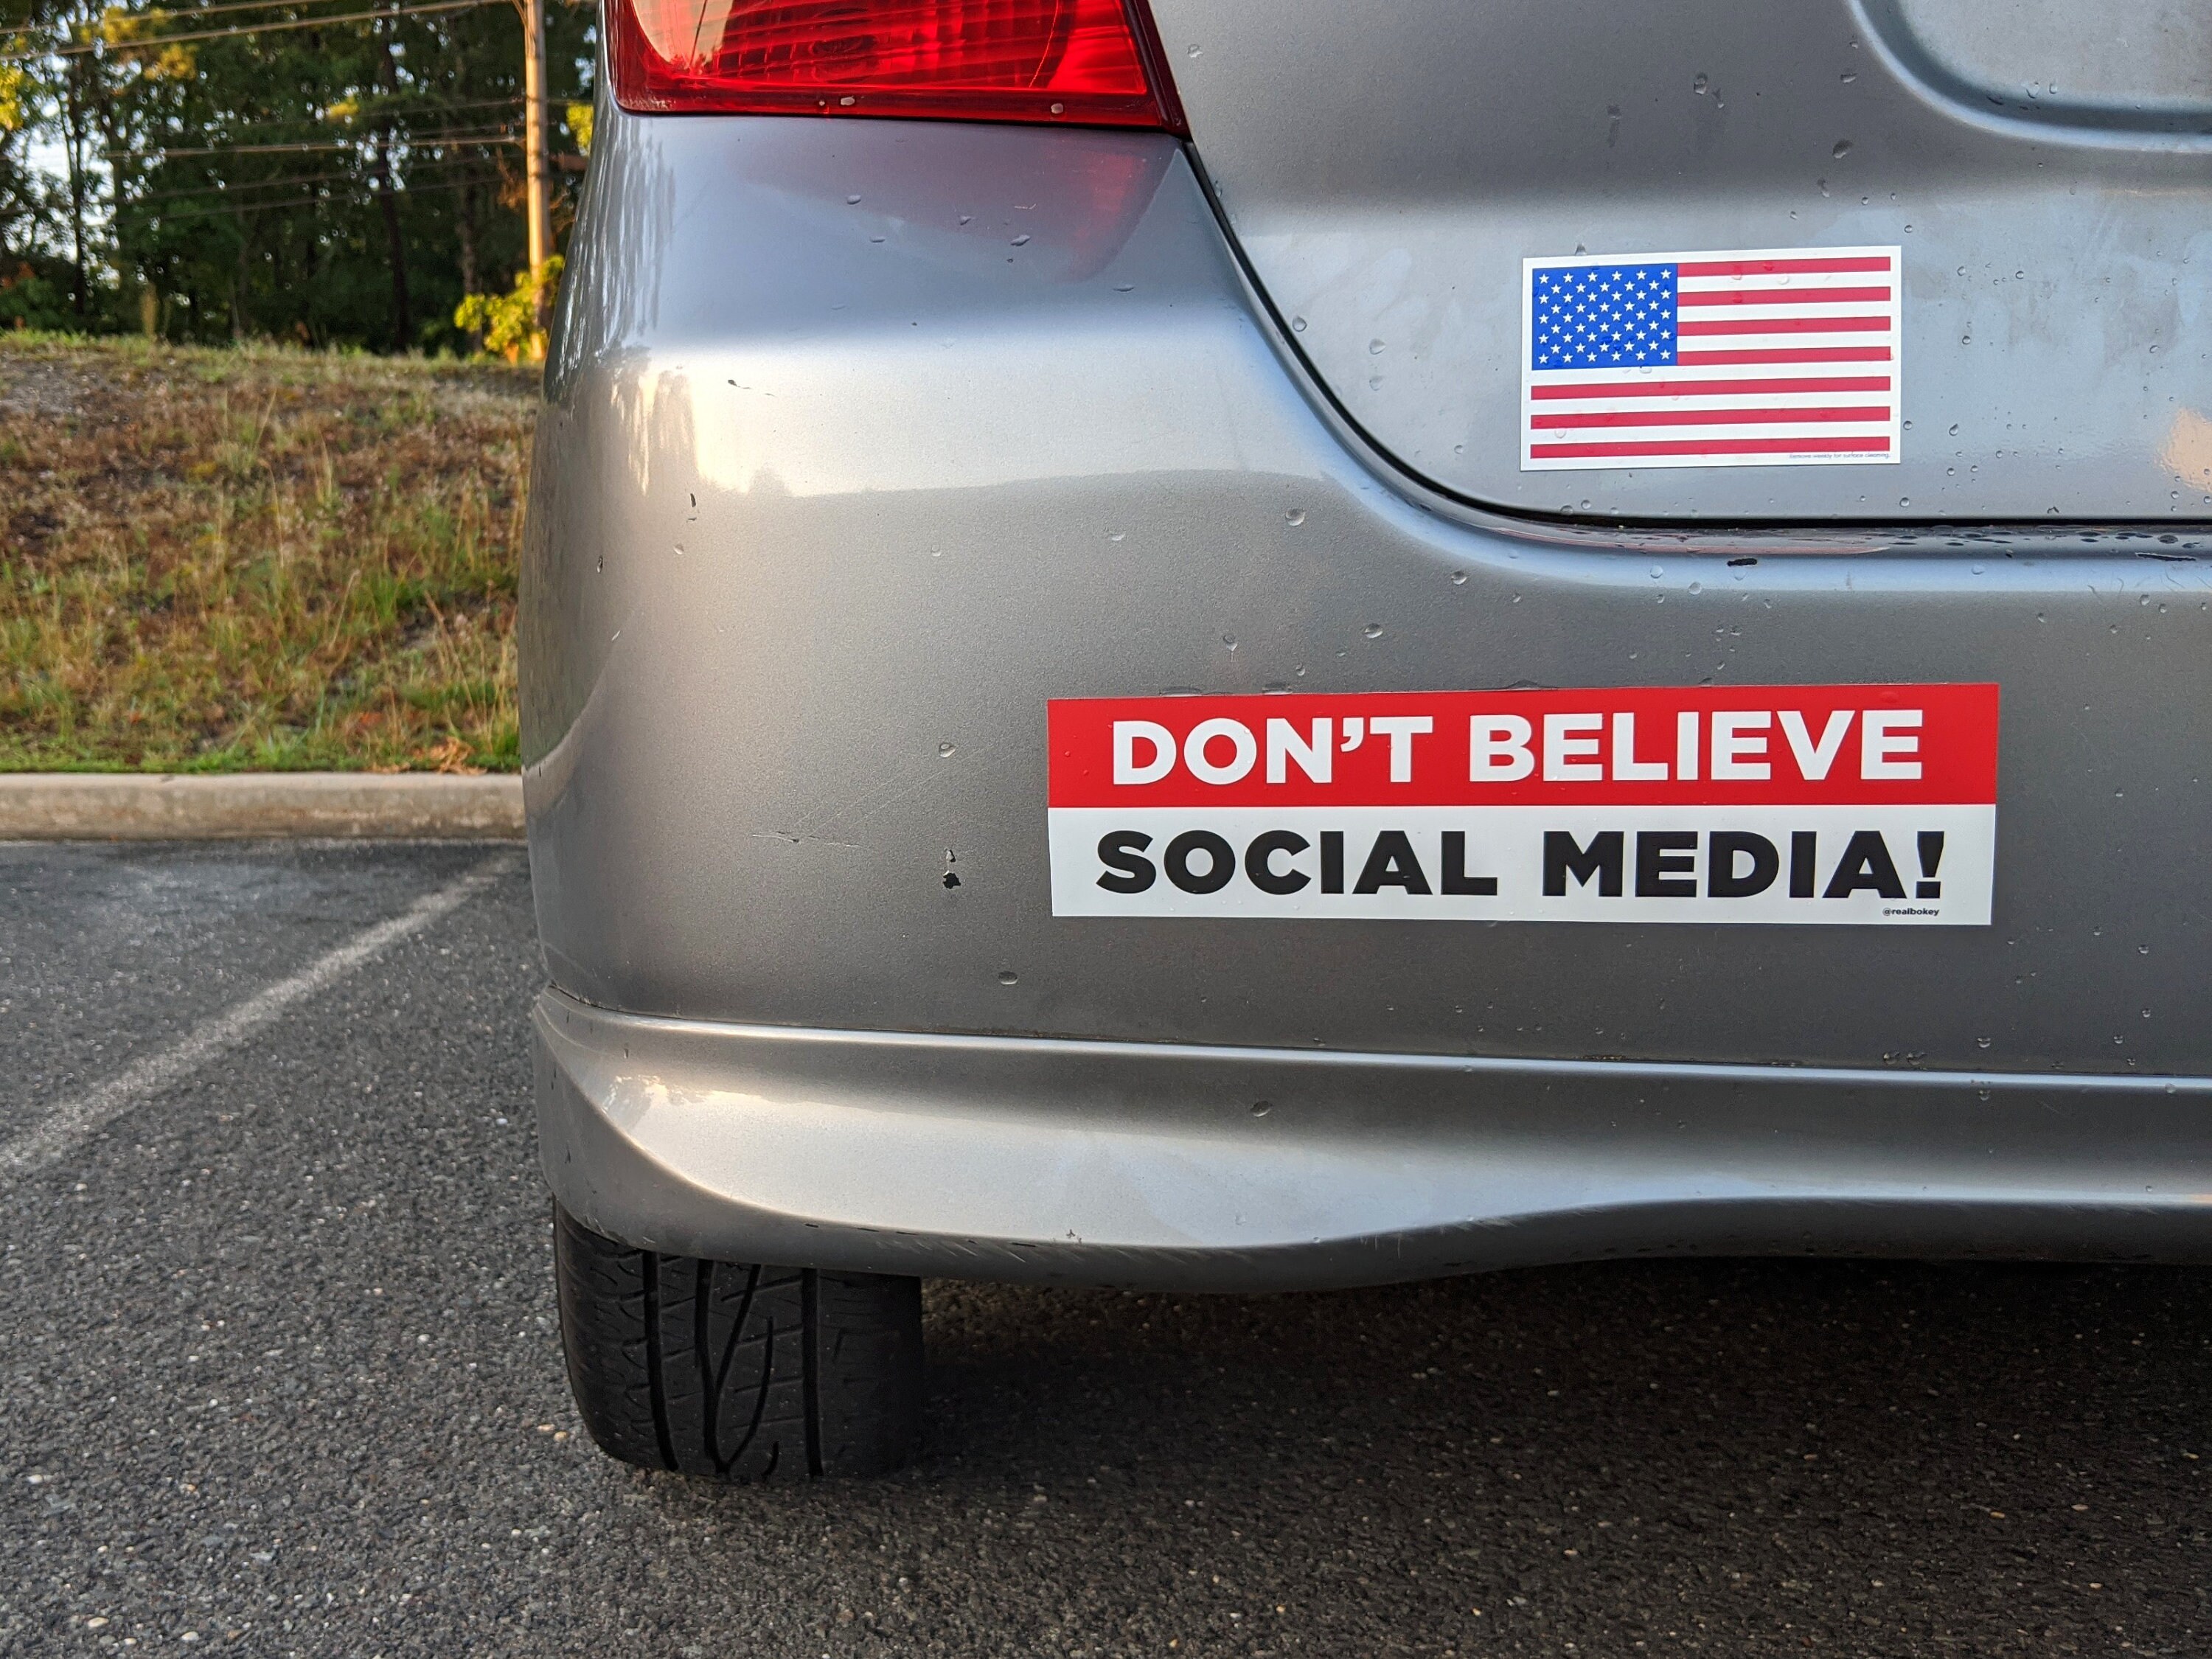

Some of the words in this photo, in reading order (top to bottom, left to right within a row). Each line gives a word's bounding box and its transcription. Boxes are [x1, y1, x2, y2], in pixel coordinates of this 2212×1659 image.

[1113, 716, 1433, 785] DON’T
[1470, 710, 1922, 782] BELIEVE
[1096, 830, 1497, 895] SOCIAL
[1543, 831, 1944, 898] MEDIA!
[1882, 907, 1940, 917] @realbokey
